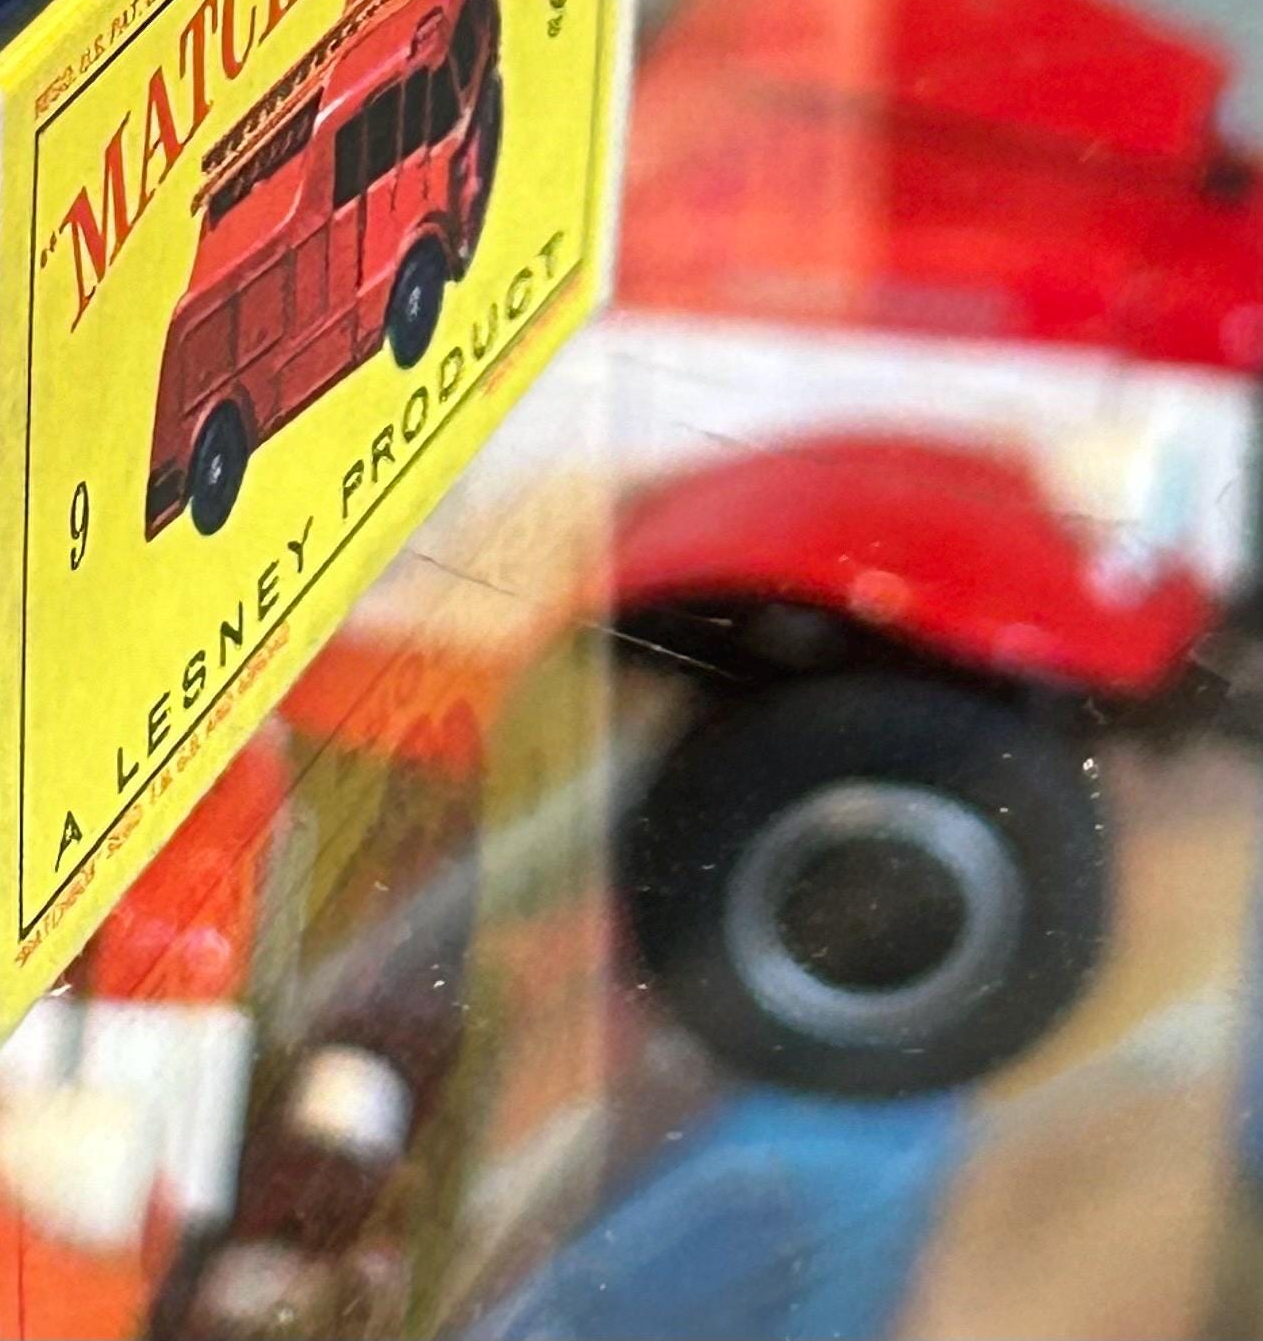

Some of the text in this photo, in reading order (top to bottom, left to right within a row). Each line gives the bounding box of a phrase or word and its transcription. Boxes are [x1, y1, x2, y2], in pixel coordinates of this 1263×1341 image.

[54, 810, 83, 873] A
[117, 515, 314, 794] LESNEY
[342, 230, 565, 520] PRODUCT
[70, 480, 90, 571] 9
